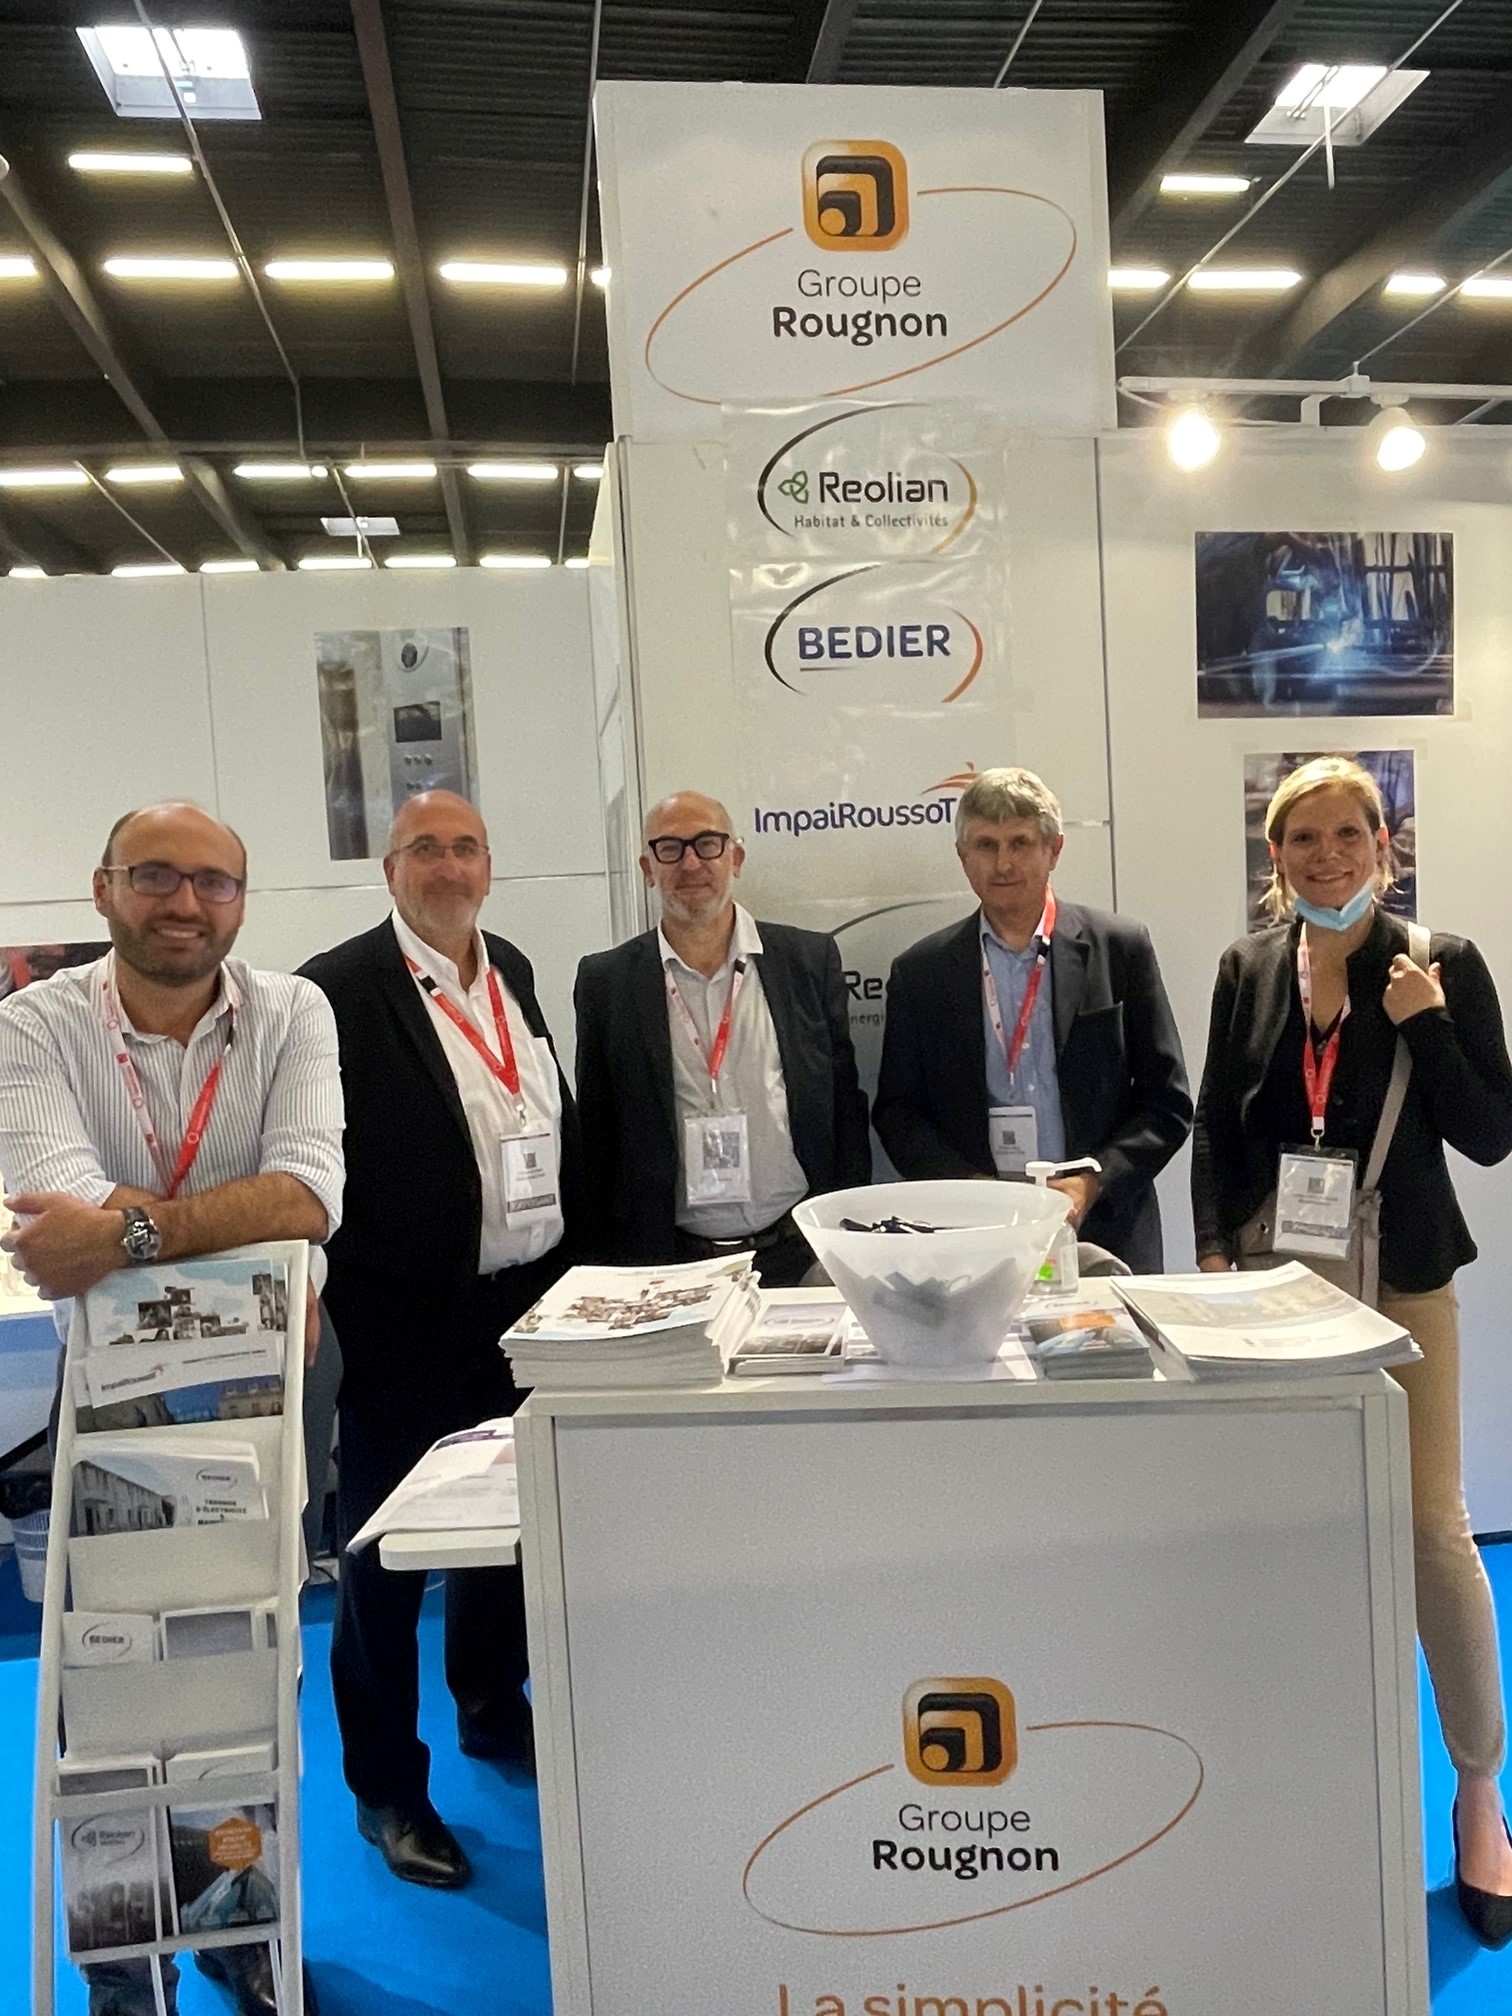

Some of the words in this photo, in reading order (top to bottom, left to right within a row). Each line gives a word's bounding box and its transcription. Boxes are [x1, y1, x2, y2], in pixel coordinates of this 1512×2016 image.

[797, 269, 922, 304] Groupe
[772, 306, 948, 346] Rougnon
[819, 471, 949, 503] Reolian
[794, 514, 846, 528] Habitat
[850, 514, 861, 528] &
[865, 513, 949, 528] Collectivités
[798, 624, 951, 660] BEDIER
[843, 970, 883, 1000] Re
[898, 1803, 1031, 1838] Groupe
[872, 1839, 1060, 1880] Rougnon
[778, 1983, 845, 2016] La
[862, 1983, 1169, 2016] simplicité
